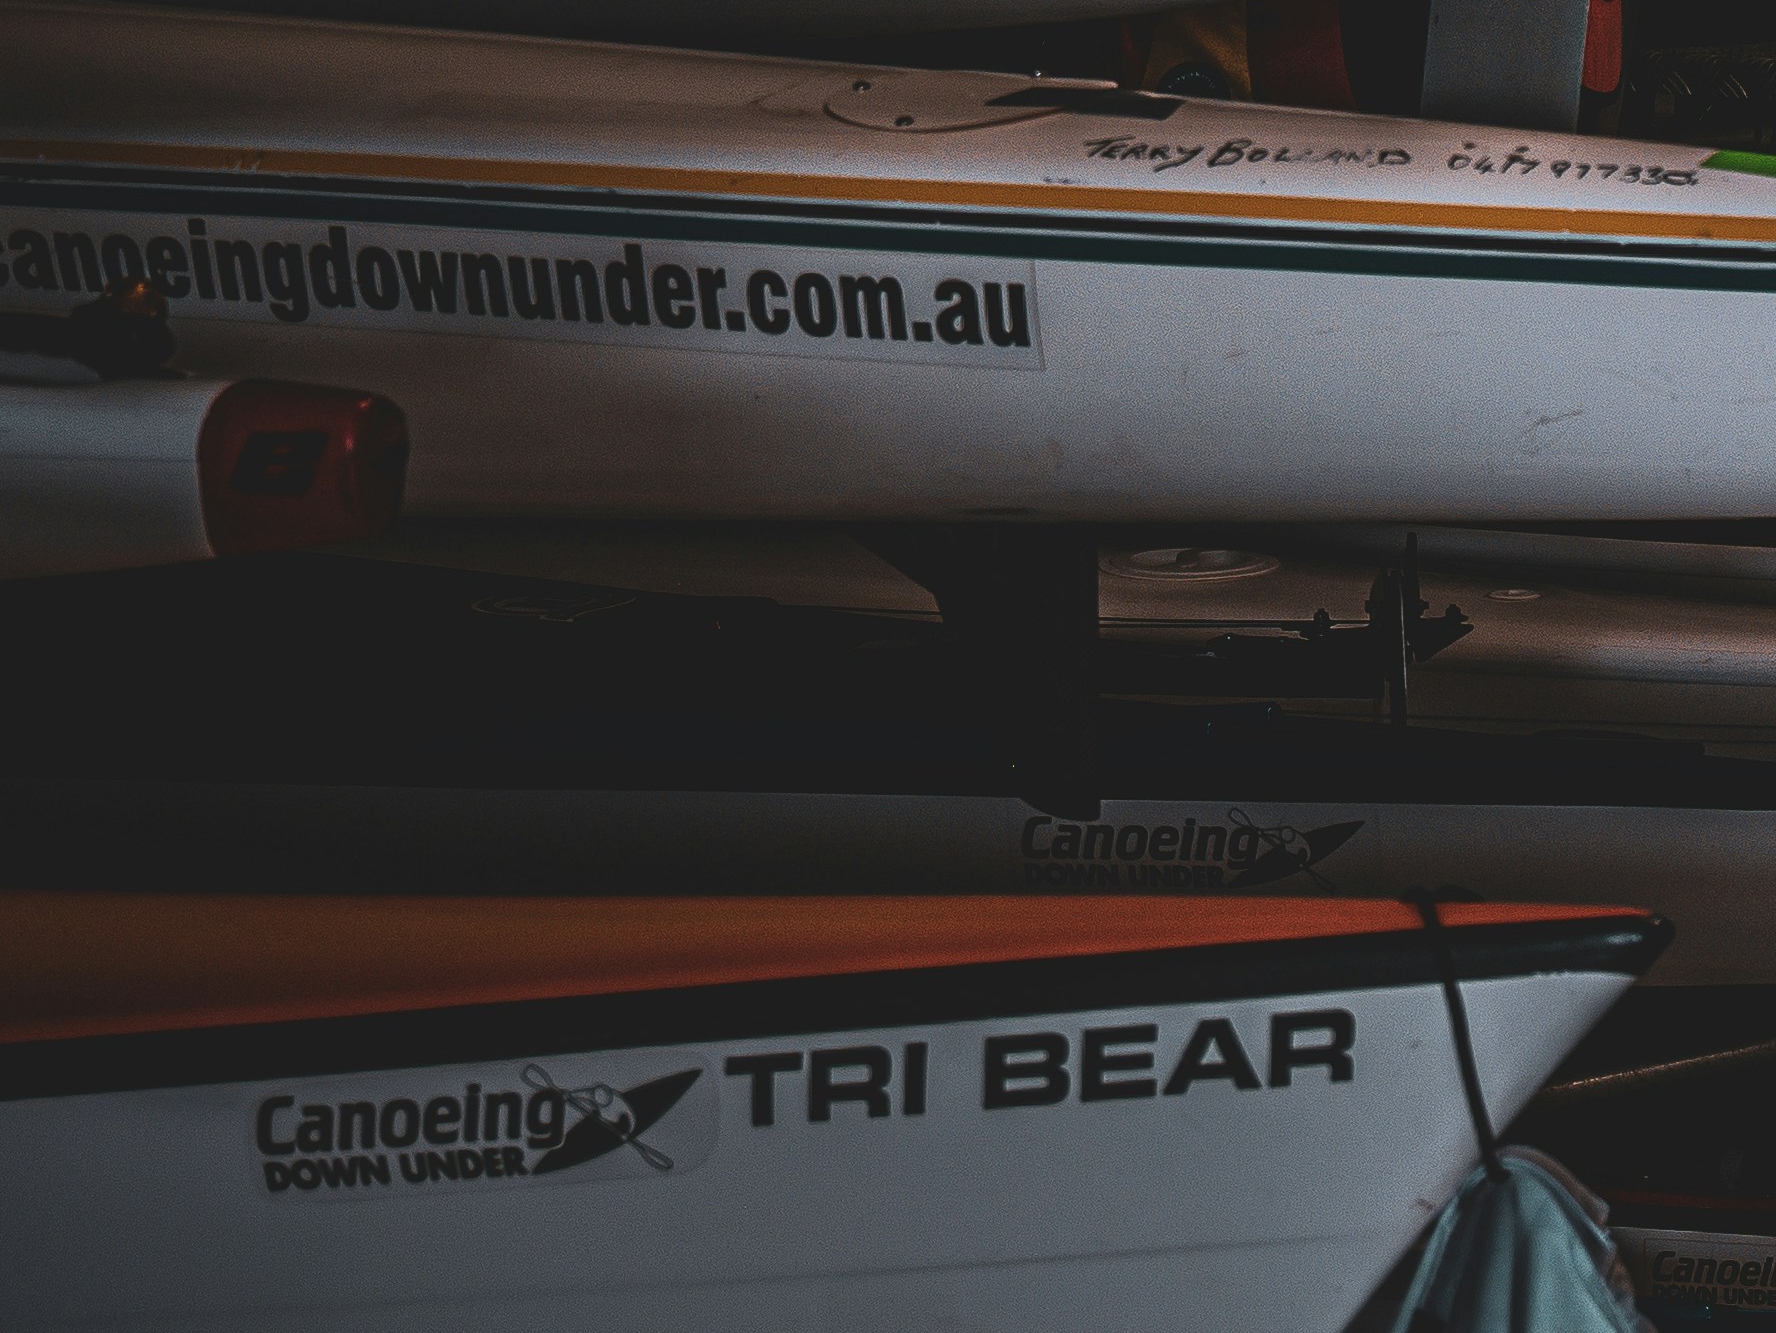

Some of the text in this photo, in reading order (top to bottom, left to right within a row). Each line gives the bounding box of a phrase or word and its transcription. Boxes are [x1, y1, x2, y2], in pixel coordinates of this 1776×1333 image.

[1085, 136, 1204, 172] TERRY
[1021, 817, 1259, 871] Canoeing
[1023, 863, 1226, 889] DOWN UNDER
[726, 1008, 1355, 1128] TRI BEAR
[256, 1084, 565, 1156] Canoeing
[263, 1146, 528, 1193] DOWN UNDER
